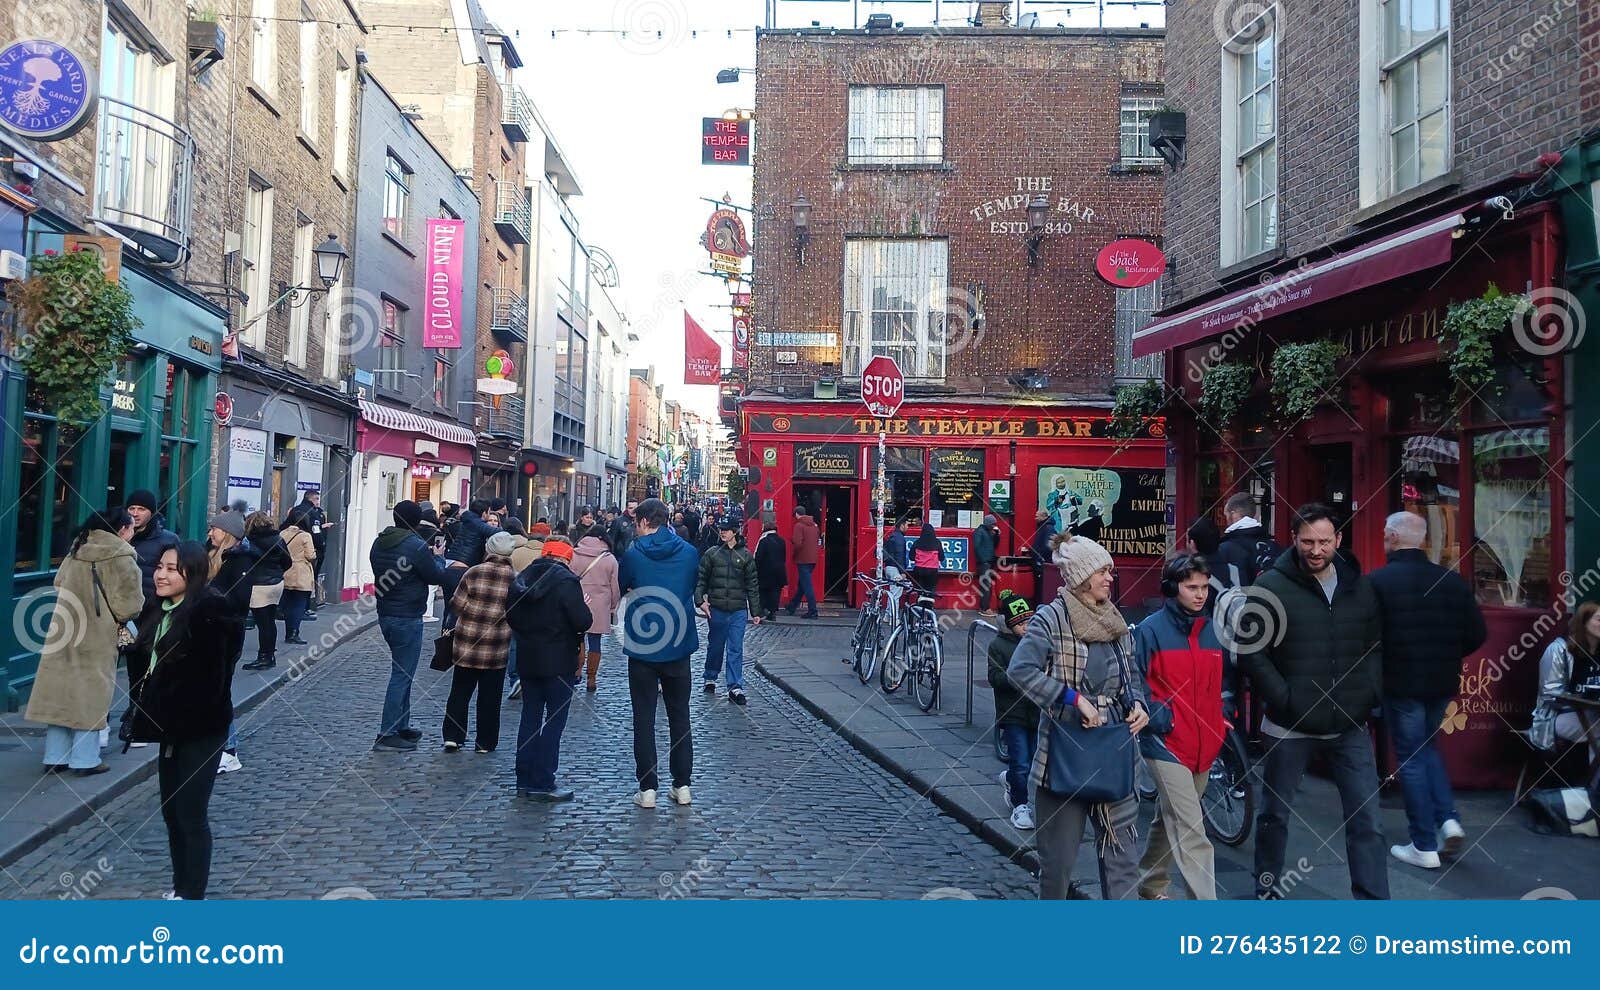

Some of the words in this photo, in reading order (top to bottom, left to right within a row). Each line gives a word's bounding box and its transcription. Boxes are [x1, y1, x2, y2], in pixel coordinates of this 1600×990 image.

[57, 52, 82, 93] YARD
[0, 74, 23, 87] OVENT
[48, 90, 79, 105] GARDEN
[714, 122, 737, 132] THE
[703, 135, 748, 146] TEMPLE
[714, 150, 737, 160] BAR
[1015, 177, 1052, 191] THE
[970, 194, 1048, 221] TEMPL
[1057, 197, 1095, 223] BAR
[990, 221, 1028, 234] ESTD
[1040, 222, 1072, 234] 840
[433, 225, 457, 265] NINE
[1109, 250, 1139, 268] Shack
[431, 272, 453, 329] CLOUD
[688, 363, 718, 371] TEMPLE
[864, 374, 902, 398] STOP
[919, 419, 1024, 436] TEMPLE
[1037, 421, 1092, 437] BAR
[803, 455, 849, 472] TOBACCO
[938, 454, 965, 463] TEMPLE
[965, 456, 980, 465] BAR
[1084, 472, 1105, 481] THE
[1074, 480, 1114, 490] TEMPLE
[1084, 490, 1105, 498] BAR
[1131, 499, 1166, 512] EMPER
[1098, 527, 1137, 540] MALTED
[1138, 524, 1166, 539] LIQUO
